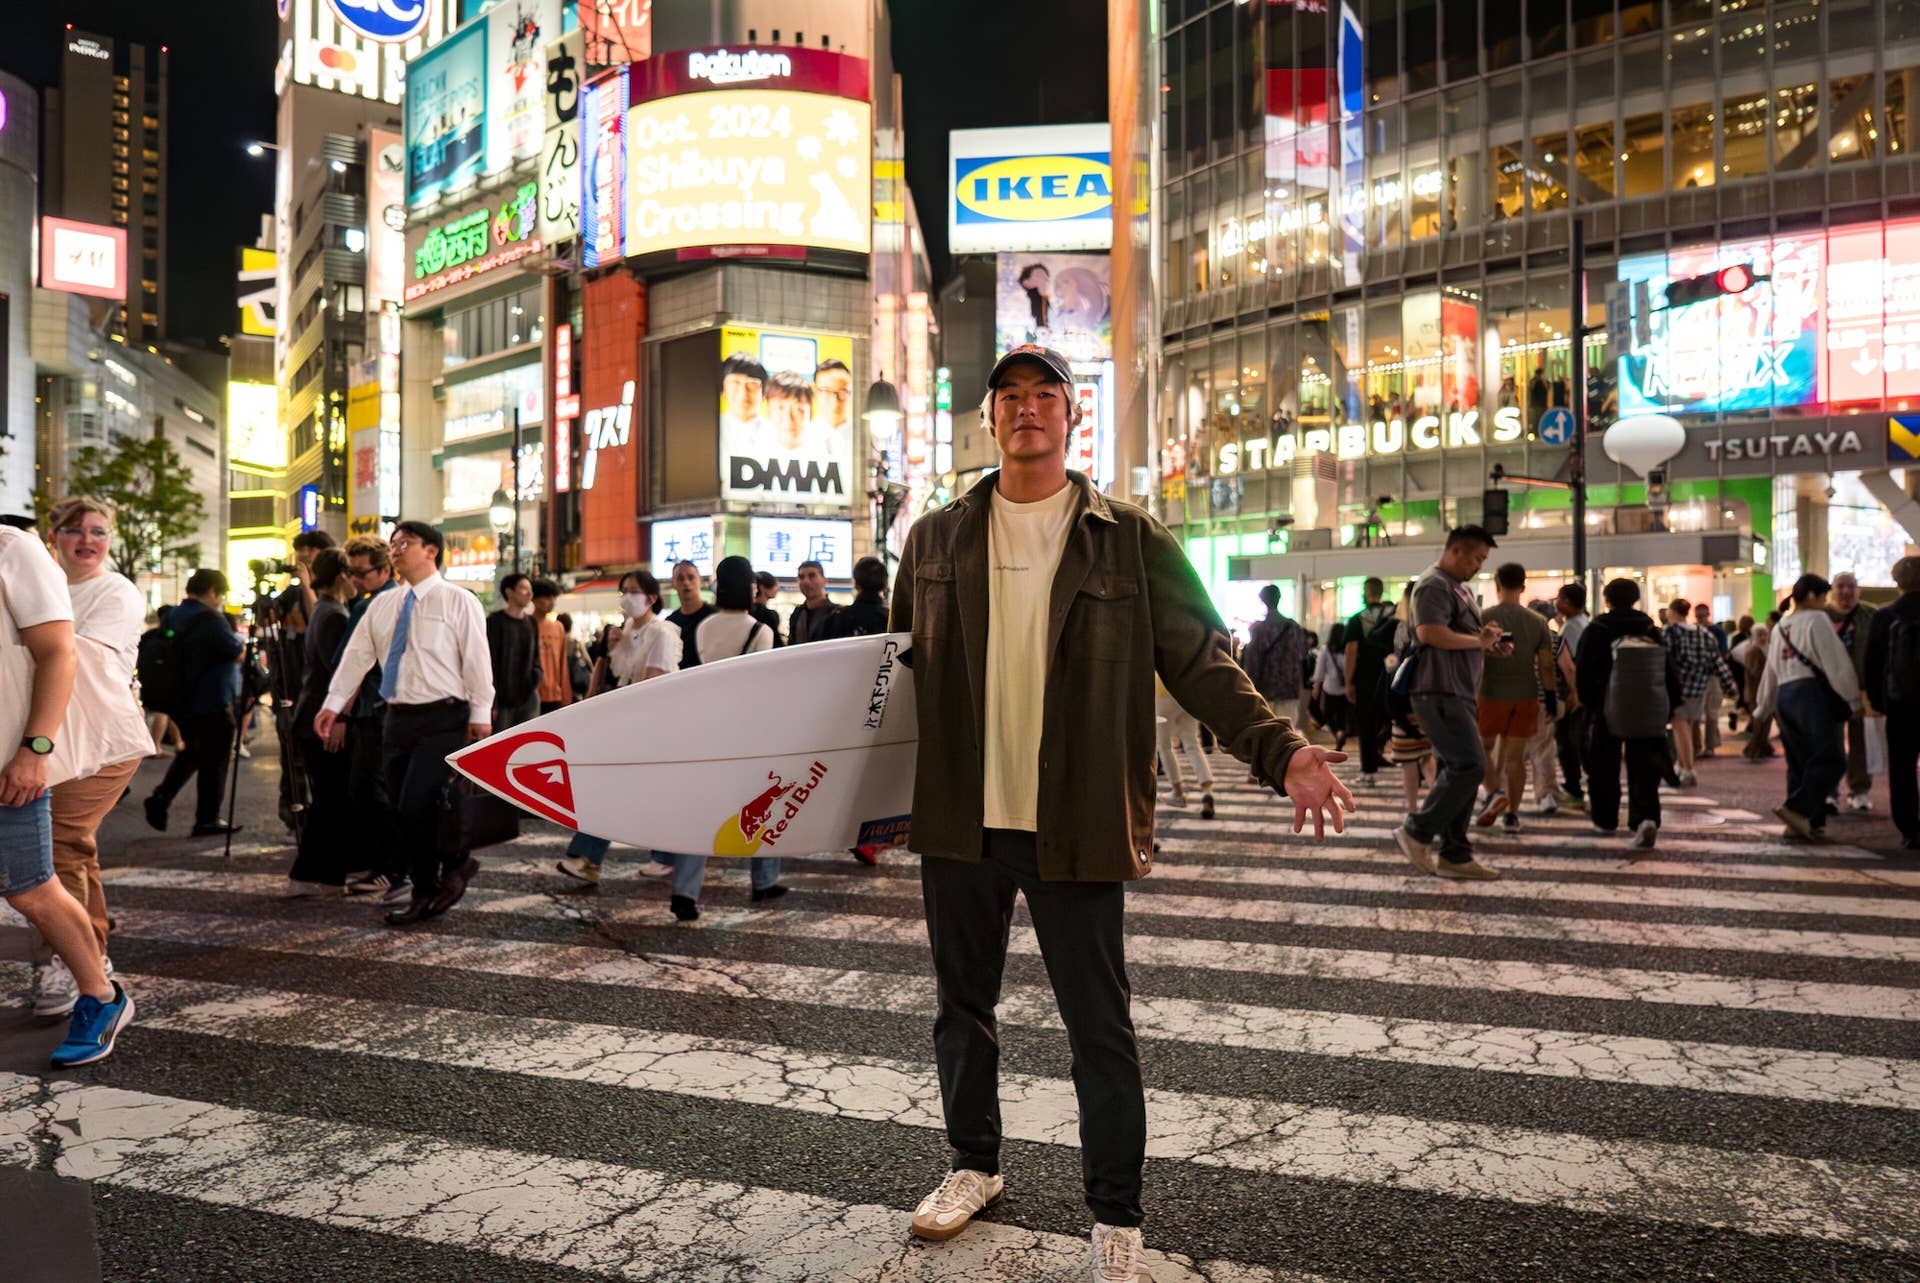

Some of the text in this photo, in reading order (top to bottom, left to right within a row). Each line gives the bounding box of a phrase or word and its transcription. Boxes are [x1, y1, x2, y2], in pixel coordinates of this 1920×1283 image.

[688, 49, 792, 80] Rakuten
[546, 43, 580, 229] もんじゃ
[637, 105, 793, 148] Oct. 2024
[636, 149, 785, 195] Shibuya
[974, 173, 1112, 203] IKEA
[636, 191, 806, 237] Crossing
[1219, 406, 1522, 474] STARBUCKS
[1704, 430, 1863, 461] TSUTAYA
[730, 456, 843, 494] DMM
[766, 532, 835, 562] 書店
[761, 760, 828, 845] Red Bull
